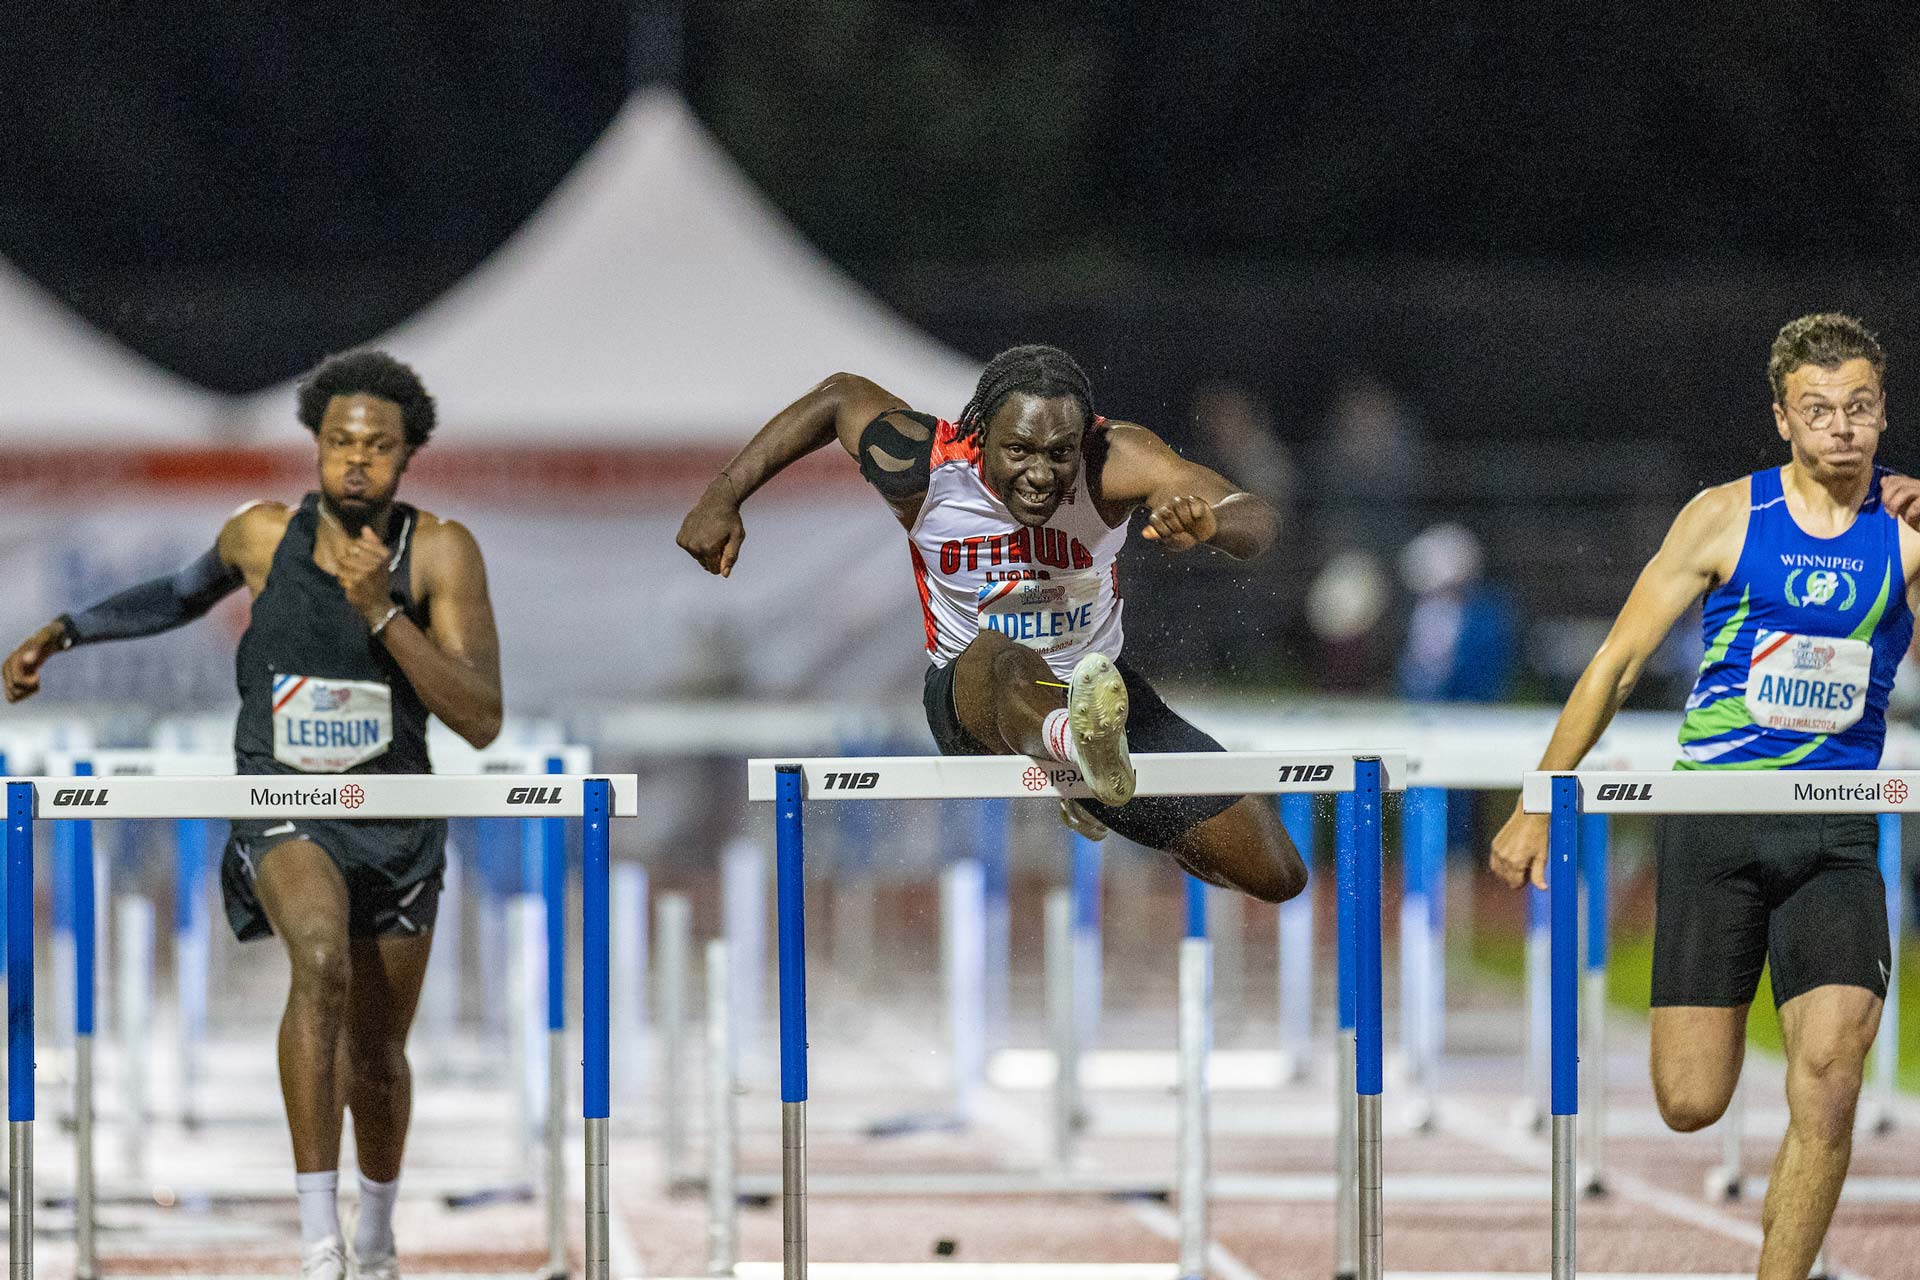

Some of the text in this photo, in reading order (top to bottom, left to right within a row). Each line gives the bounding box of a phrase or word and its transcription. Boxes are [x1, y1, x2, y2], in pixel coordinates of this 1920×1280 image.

[940, 527, 1093, 575] OTTAWA
[1779, 553, 1865, 573] WINNIPEG
[985, 569, 1051, 583] LIONS
[987, 602, 1094, 641] ADELEYE
[1757, 674, 1857, 711] ANDRES
[287, 717, 380, 748] LEBRUN
[824, 773, 879, 789] GILL
[1279, 765, 1334, 782] GILL
[54, 790, 108, 805] GILL
[251, 789, 336, 805] Montréal
[507, 788, 561, 804] GILL
[1597, 784, 1652, 800] GILL
[1795, 784, 1880, 800] Montréal
